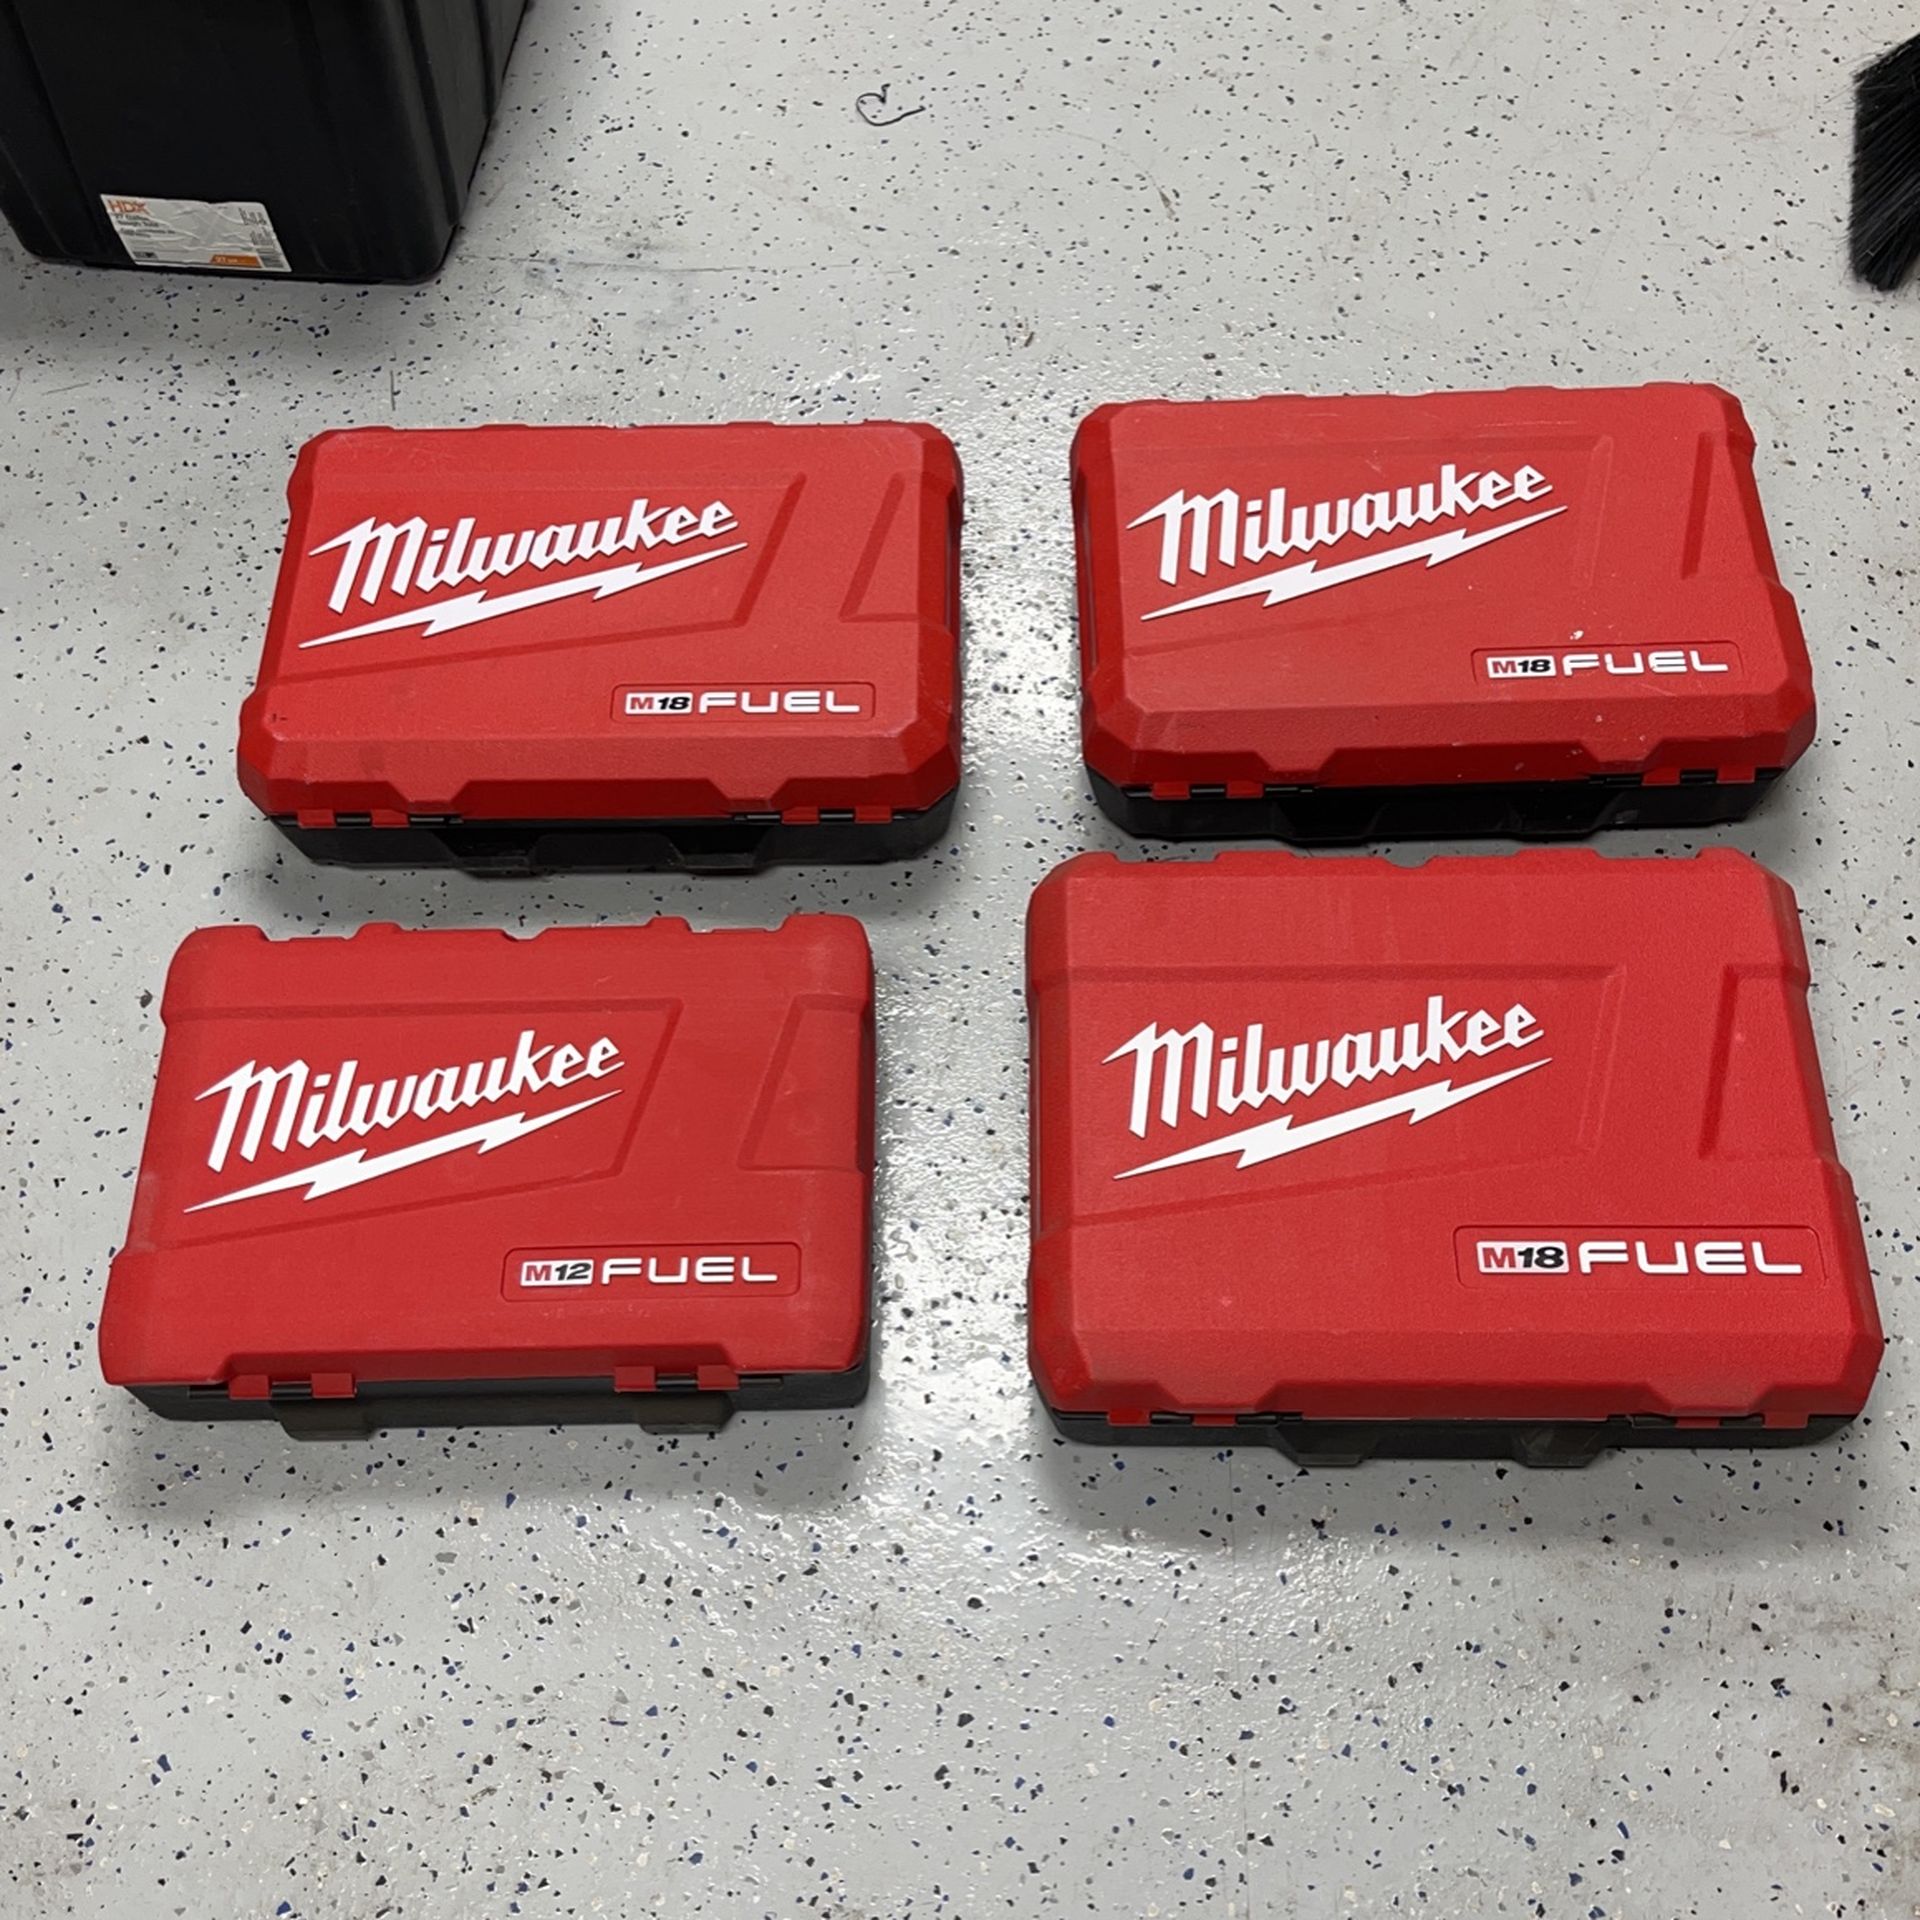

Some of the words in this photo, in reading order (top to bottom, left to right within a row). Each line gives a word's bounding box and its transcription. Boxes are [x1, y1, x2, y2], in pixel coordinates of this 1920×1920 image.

[108, 200, 150, 215] HDX
[1126, 464, 1552, 584] Milwaukee
[309, 499, 738, 613] Milwaukee
[1492, 658, 1552, 675] M18
[1562, 651, 1728, 675] FUEL
[629, 696, 690, 712] M18
[699, 691, 860, 713] FUEL
[1102, 996, 1544, 1137] Milwaukee
[195, 1030, 624, 1172] Milwaukee
[524, 1262, 592, 1282] M12
[602, 1257, 777, 1284] FUEL
[1482, 1244, 1565, 1269] M18
[1579, 1241, 1802, 1273] FUEL
